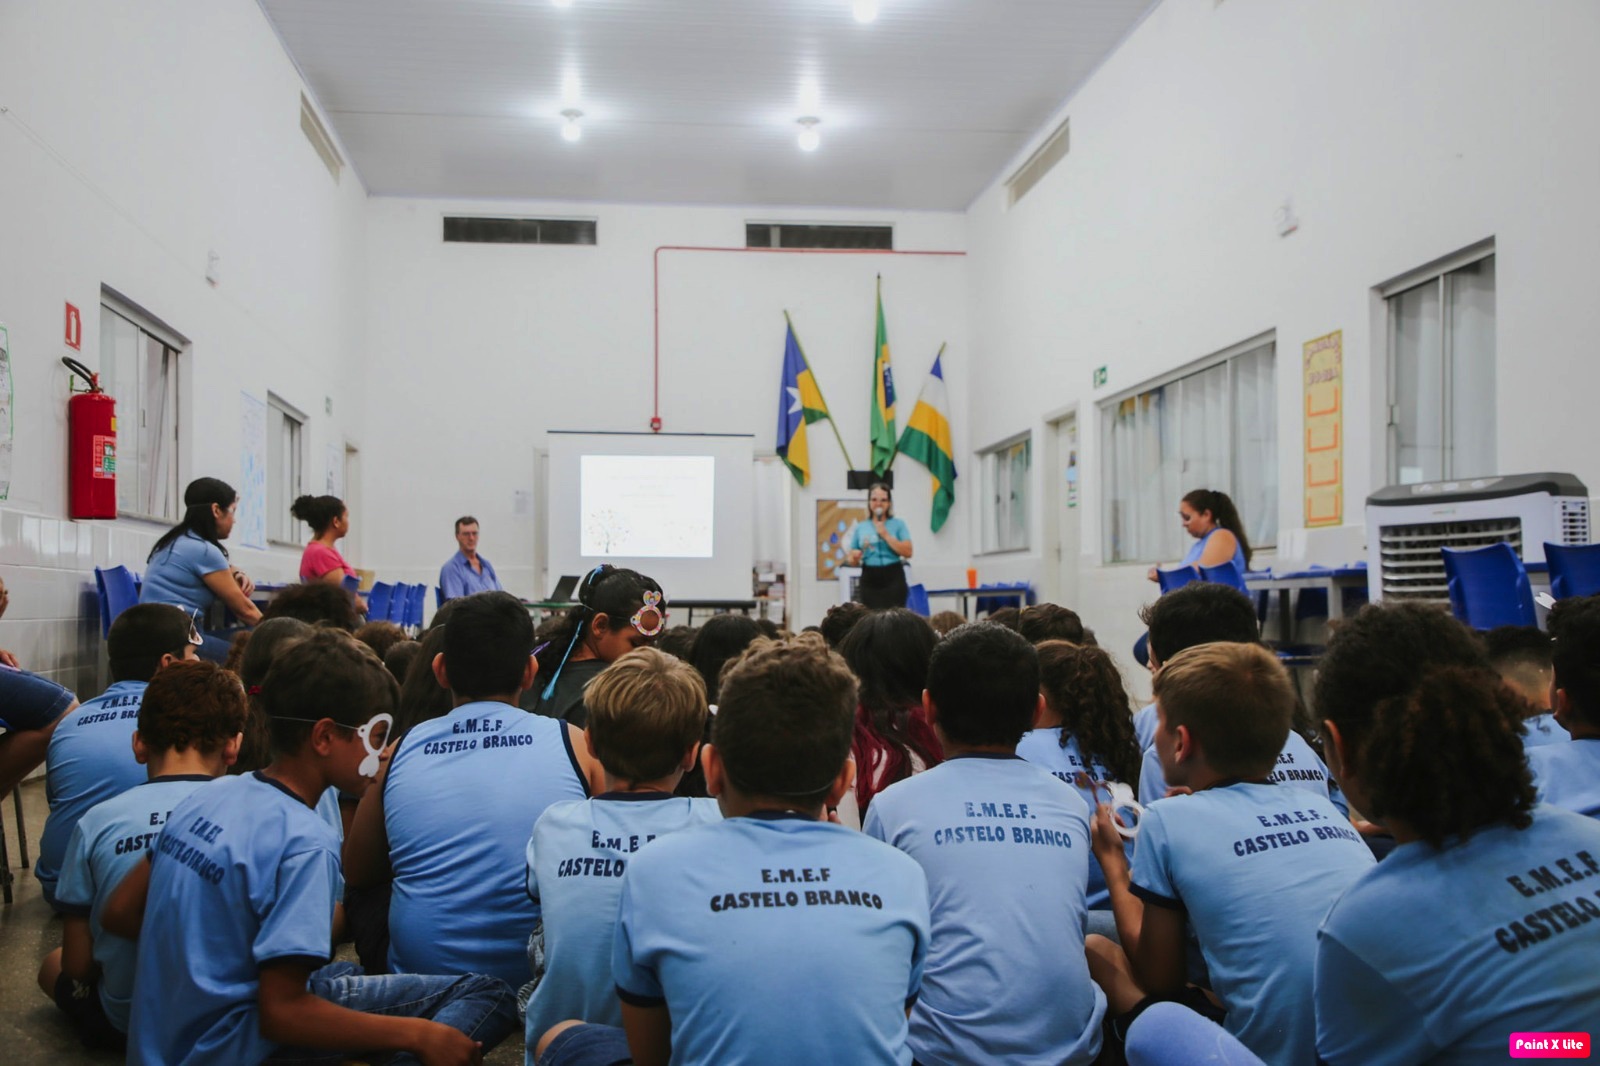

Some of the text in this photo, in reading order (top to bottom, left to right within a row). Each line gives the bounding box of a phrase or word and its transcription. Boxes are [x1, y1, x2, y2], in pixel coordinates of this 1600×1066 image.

[77, 711, 117, 726] CASTELO
[424, 734, 533, 754] CASTELO BRANCO
[964, 802, 1037, 819] E.M.E.F.
[934, 826, 1072, 848] CASTELO BRANCO
[1233, 830, 1310, 857] CASTELO
[558, 858, 625, 877] CASTELO
[761, 868, 831, 883] E.M.E.F
[710, 890, 883, 912] CASTELO BRANCO
[1495, 897, 1600, 953] CASTELO
